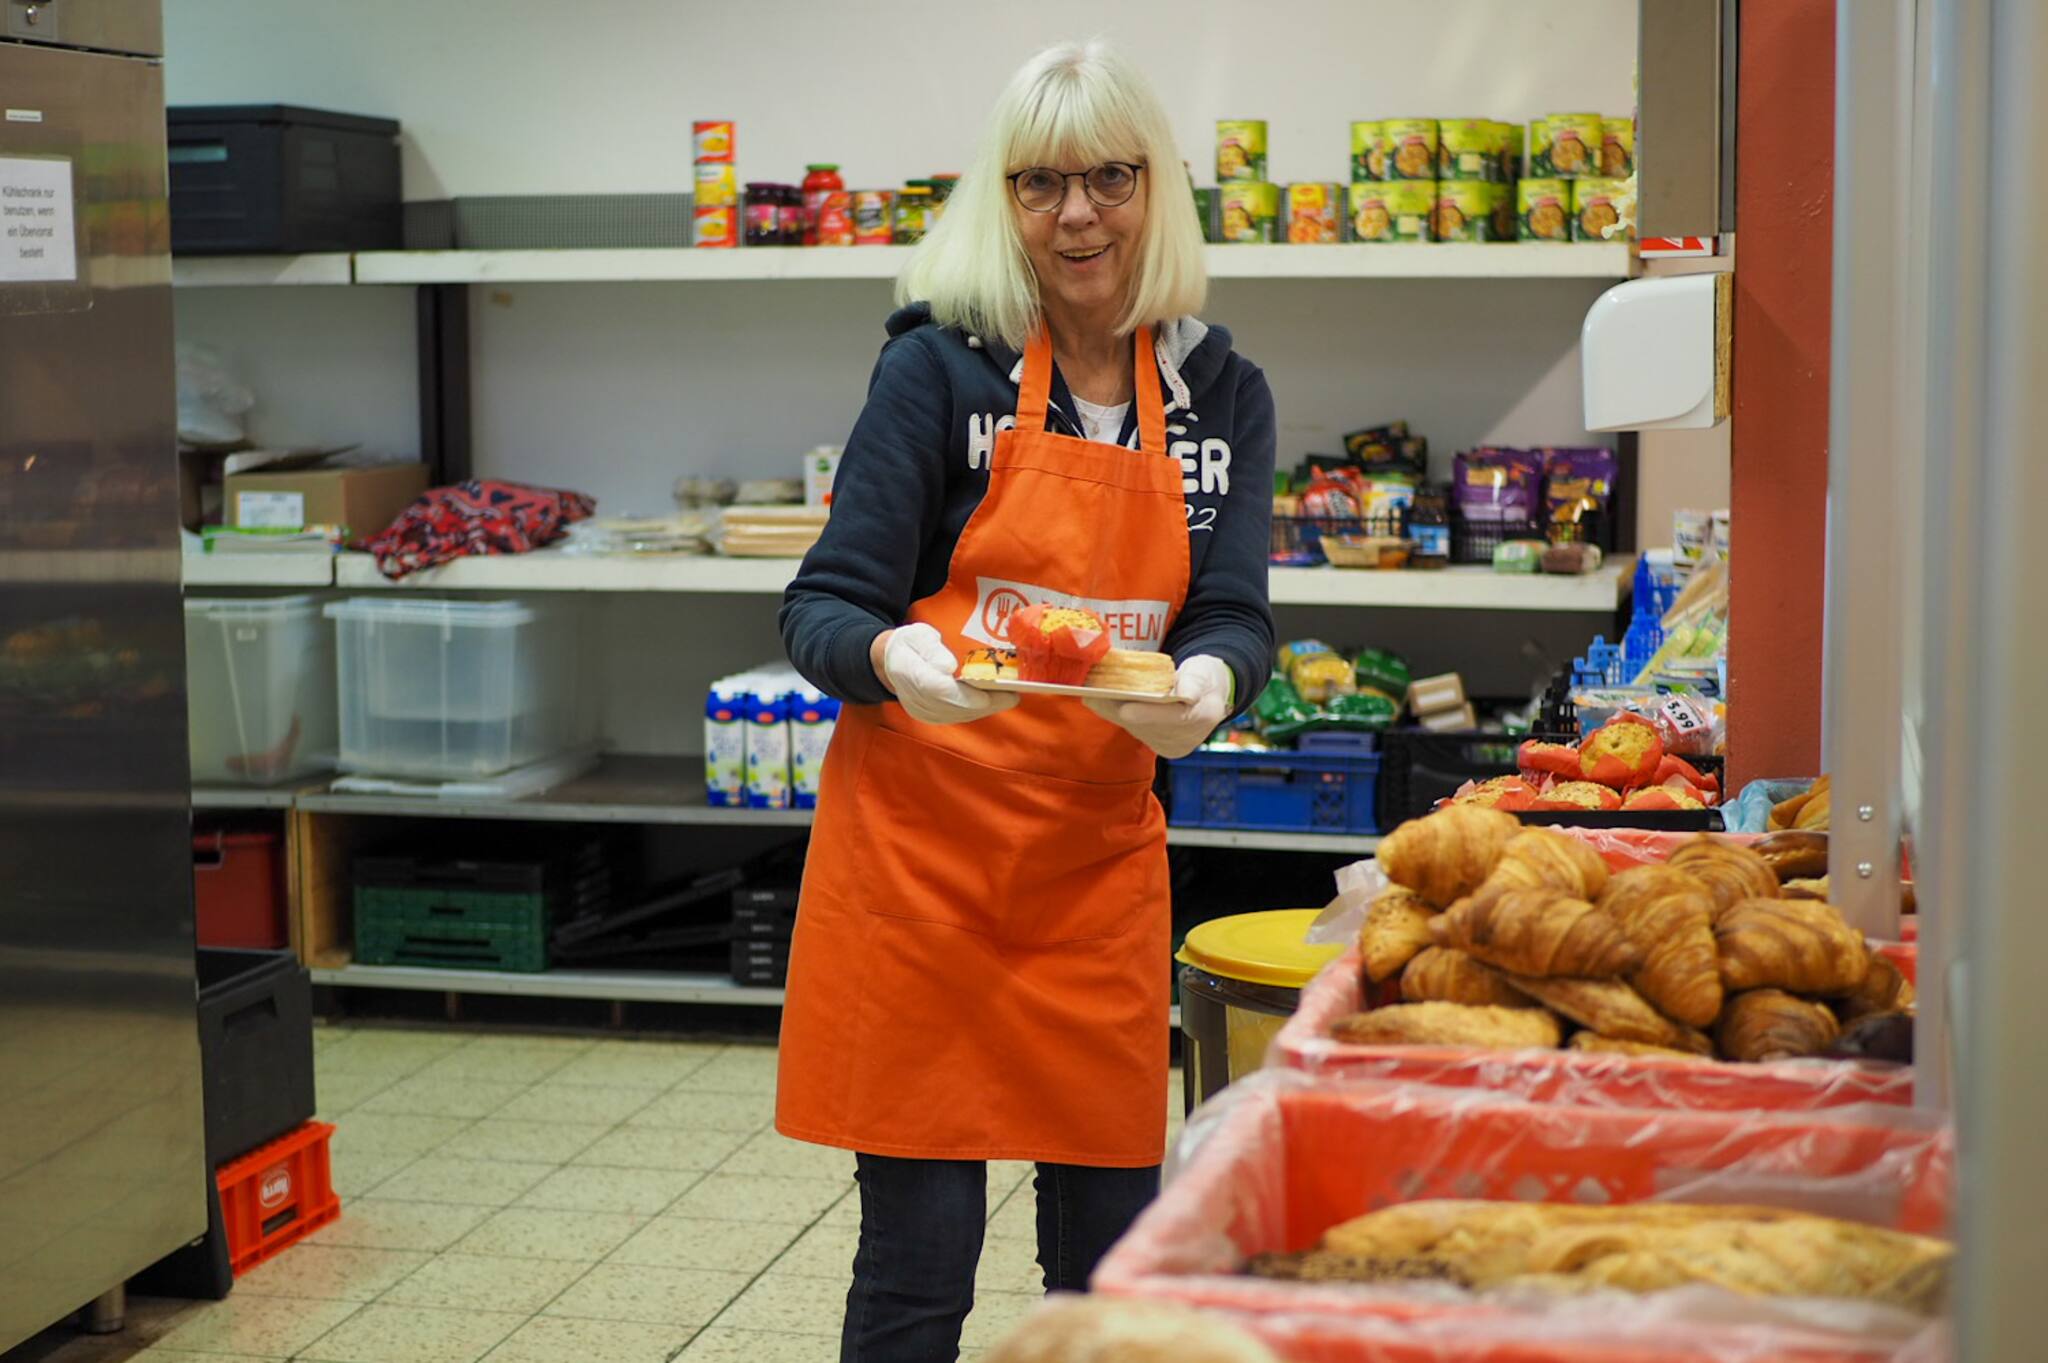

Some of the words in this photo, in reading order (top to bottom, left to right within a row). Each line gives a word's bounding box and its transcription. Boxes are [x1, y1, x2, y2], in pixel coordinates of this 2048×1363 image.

[2, 185, 42, 198] Kühlschrank
[44, 188, 55, 198] nur
[3, 204, 36, 217] benutzen,
[38, 207, 55, 216] wenn
[7, 226, 17, 237] ein
